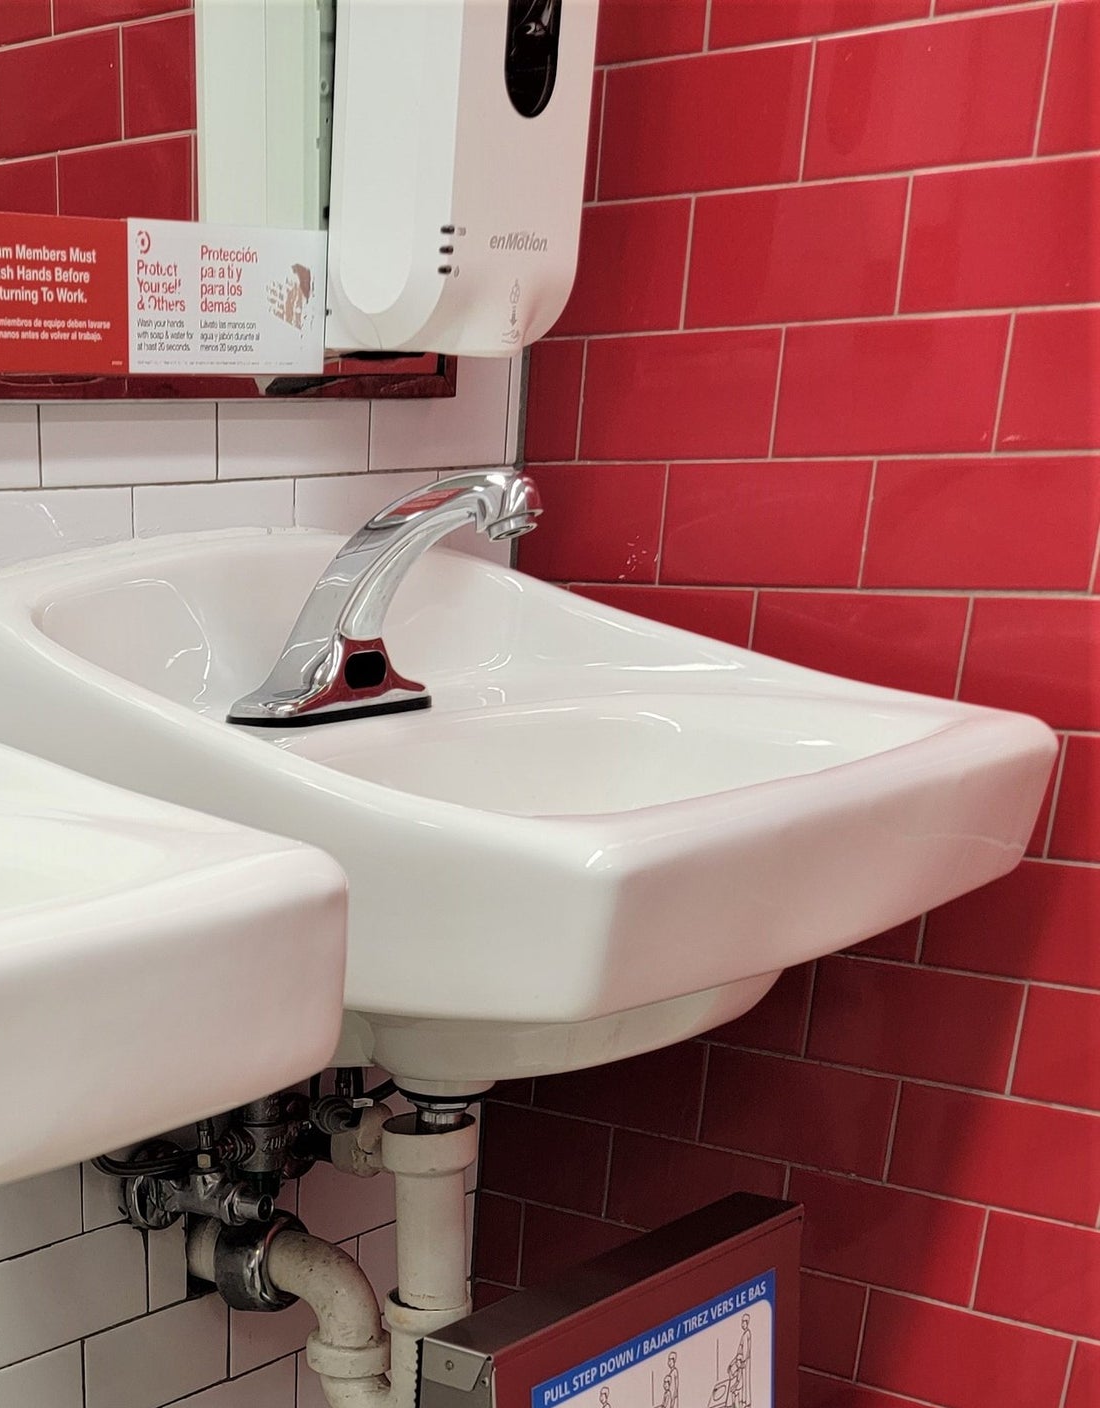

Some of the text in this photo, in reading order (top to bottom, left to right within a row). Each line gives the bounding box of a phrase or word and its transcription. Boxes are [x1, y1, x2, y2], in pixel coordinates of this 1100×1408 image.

[490, 231, 548, 251] enMotion
[15, 244, 67, 262] Members
[69, 247, 96, 264] Must
[201, 245, 258, 263] Protección
[17, 265, 52, 281] Hands
[55, 267, 90, 283] Before
[137, 259, 178, 276] Protect
[228, 264, 234, 279] ti
[235, 267, 242, 282] y
[41, 286, 54, 302] To
[56, 287, 88, 303] Work.
[201, 281, 243, 298] para los
[137, 295, 145, 311] &
[200, 297, 237, 313] demás
[0, 317, 33, 327] miembros
[33, 317, 42, 328] de
[43, 318, 66, 329] equipo
[67, 318, 87, 328] deben
[88, 319, 111, 329] lavarse
[21, 330, 40, 339] antes
[40, 330, 49, 340] de
[50, 331, 70, 340] volver
[71, 331, 77, 340] al
[78, 331, 102, 342] trabajo.
[543, 1283, 766, 1406] PULL STEP DOWN BAJAR TIREZ VERS LE BAS
